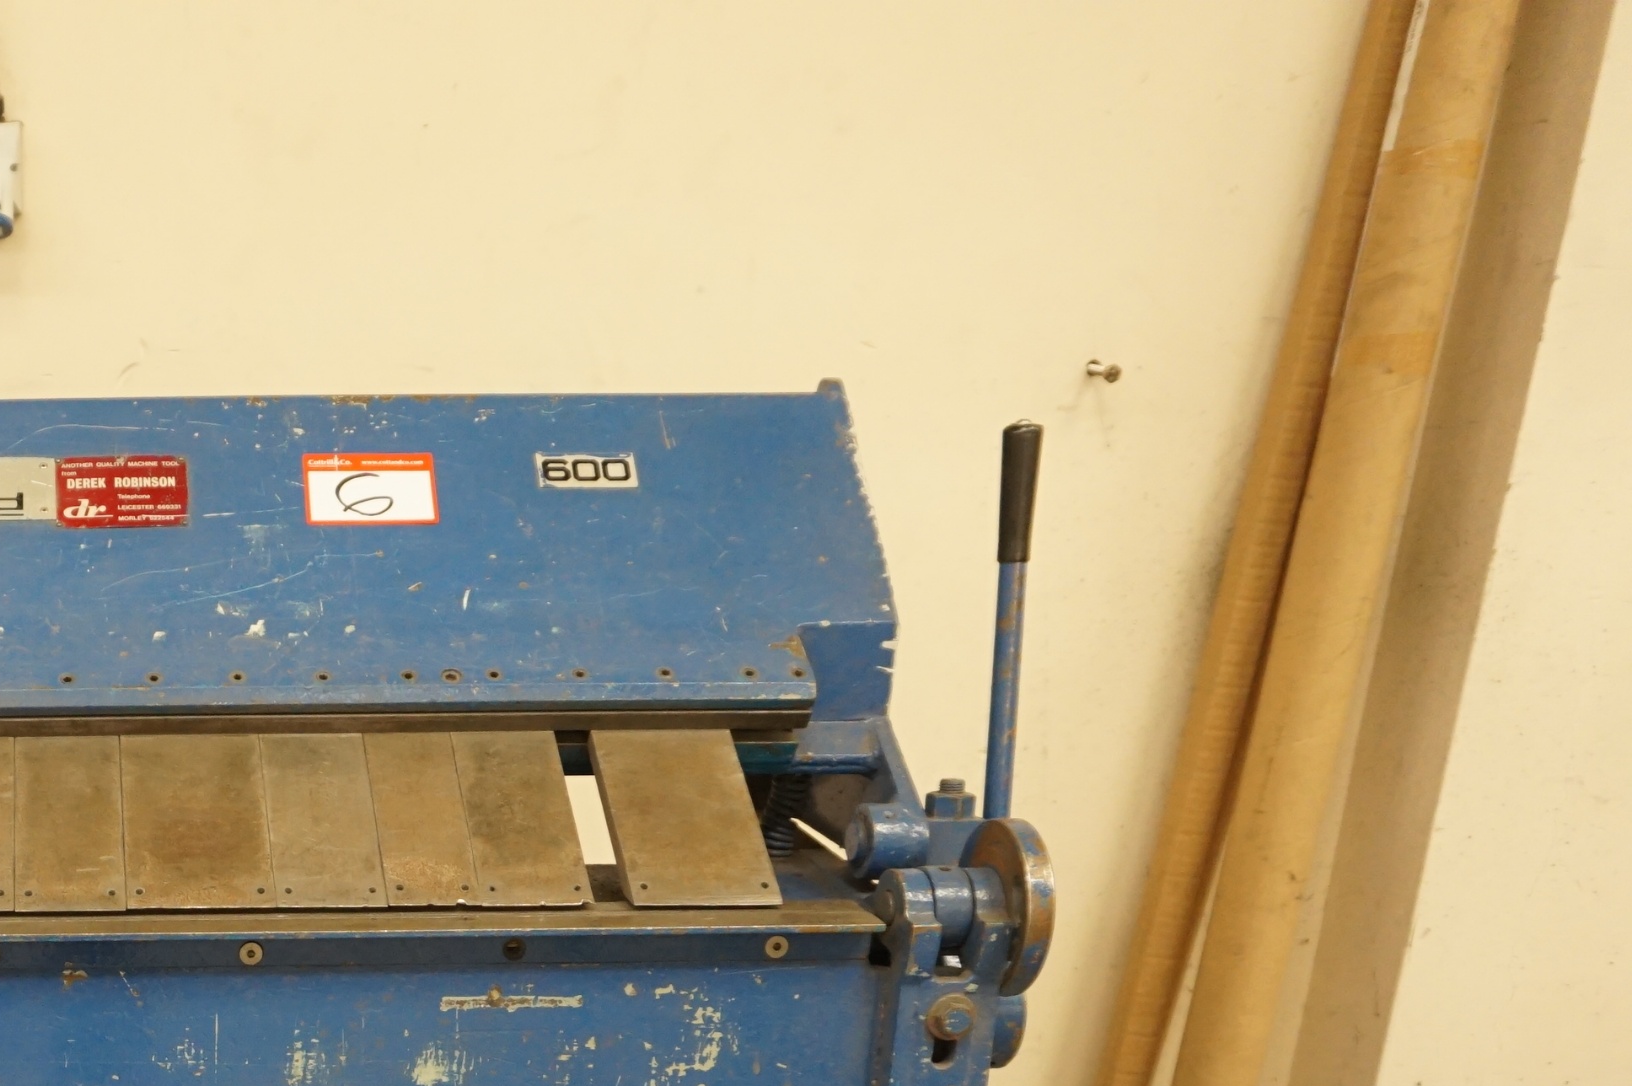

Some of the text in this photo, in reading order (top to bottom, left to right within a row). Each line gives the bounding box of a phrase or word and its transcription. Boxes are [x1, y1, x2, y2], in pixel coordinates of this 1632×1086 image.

[541, 459, 631, 481] 600
[66, 476, 176, 489] DEREK ROBINSON
[335, 472, 394, 516] 6
[63, 498, 110, 518] dr
